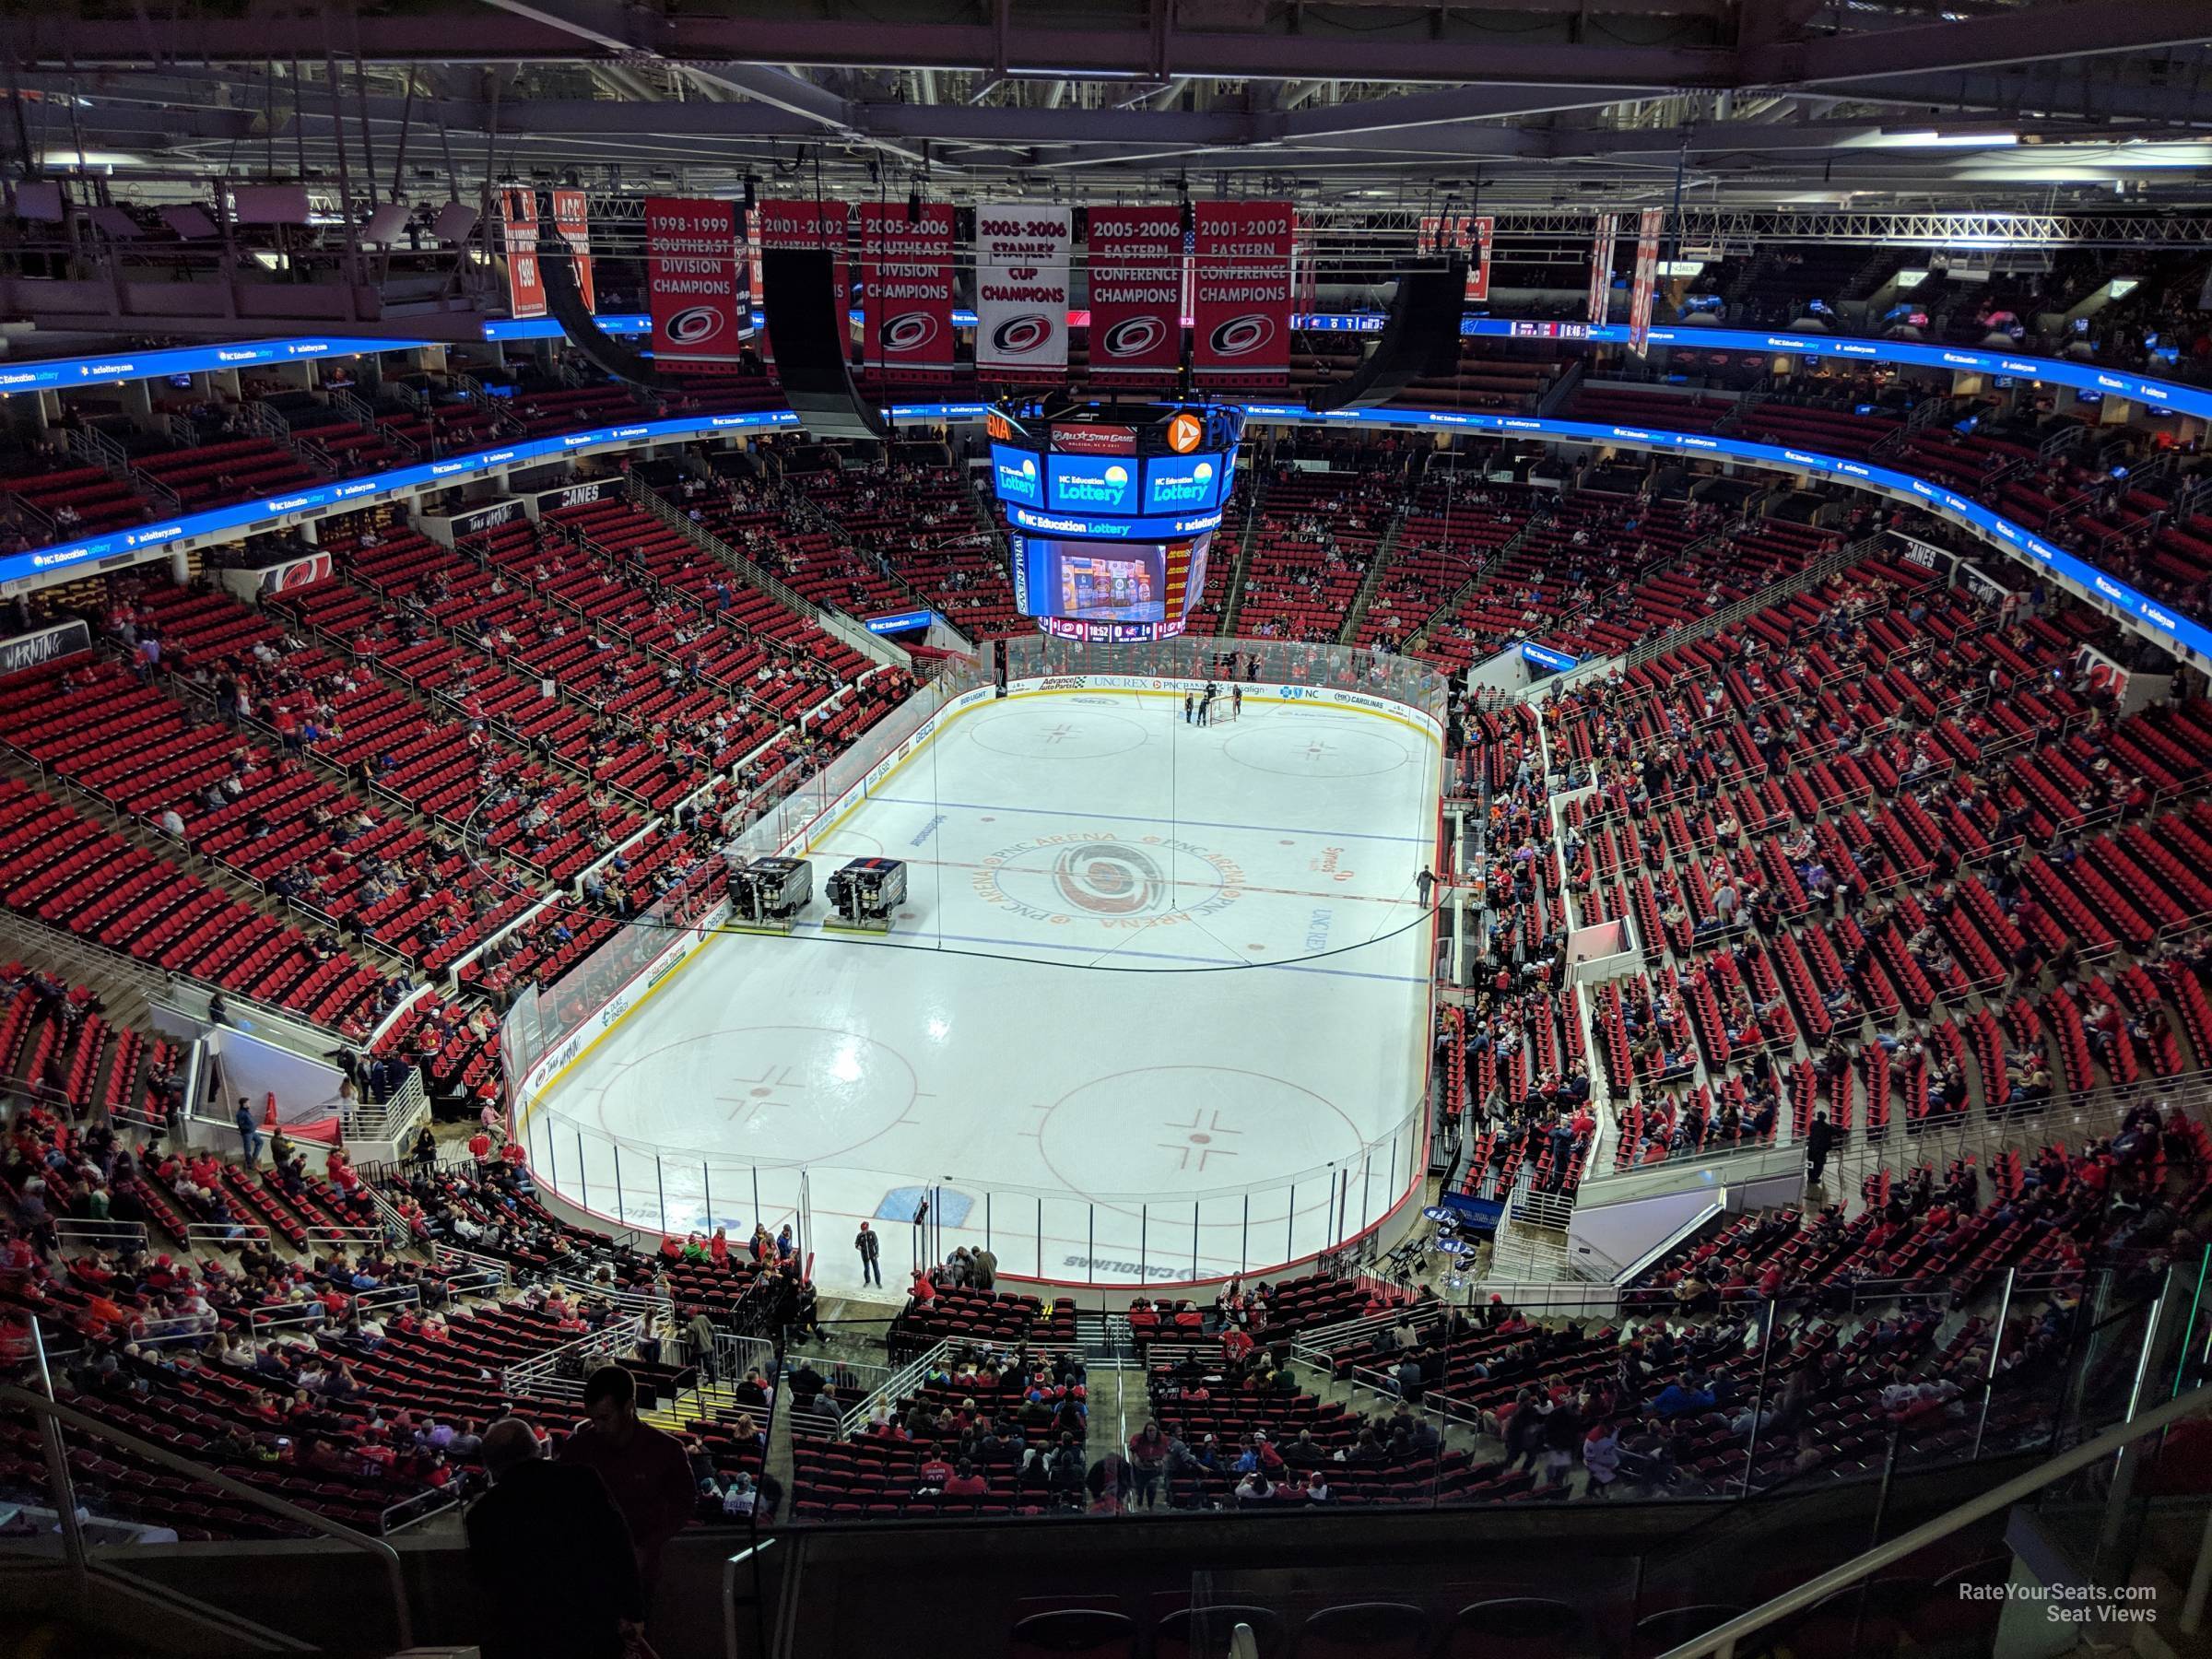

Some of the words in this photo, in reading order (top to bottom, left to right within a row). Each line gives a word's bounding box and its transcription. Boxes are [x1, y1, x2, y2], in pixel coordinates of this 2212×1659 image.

[651, 217, 728, 233] 1998-1999
[764, 219, 842, 235] 2001-2002
[865, 218, 949, 235] 2005-2006
[981, 219, 1067, 238] 2005-2006
[1093, 221, 1180, 238] 2005-2006
[1201, 220, 1288, 237] 2001-2002
[651, 237, 730, 253] SOUTHEAST
[865, 240, 949, 255] SOUTHEAST
[992, 242, 1055, 259] STANLEY
[1104, 243, 1169, 257] EASTERN
[1211, 242, 1276, 257] EASTERN
[661, 258, 722, 274] DIVISION
[876, 265, 939, 277] DIVISION
[1008, 266, 1038, 281] CUP
[1093, 267, 1179, 281] CONFERENCE
[1200, 265, 1288, 281] CONFERENCE
[653, 278, 731, 295] CHAMPIONS
[866, 283, 948, 300] CHAMPIONS
[980, 285, 1065, 303] CHAMPIONS
[1199, 286, 1287, 302] CHAMPIONS
[1093, 287, 1178, 304] CHAMPIONS
[92, 363, 134, 375] nclottery.com
[4, 373, 36, 384] Education
[1086, 433, 1110, 441] STAR
[1110, 434, 1136, 442] GAME
[1000, 472, 1035, 499] Lottery
[1058, 476, 1070, 484] NC
[1071, 476, 1105, 486] Education
[1155, 477, 1165, 486] NC
[1165, 477, 1194, 485] Education
[561, 485, 599, 507] CANES
[1058, 482, 1124, 506] Lottery
[1153, 484, 1208, 502] Lottery
[1025, 514, 1038, 525] NC
[1037, 516, 1087, 532] Education
[1088, 522, 1130, 536] Lottery
[140, 525, 182, 543] nclottery.com
[43, 555, 54, 565] NC
[54, 548, 88, 563] Education
[1904, 541, 1936, 568] CANES
[886, 620, 911, 629] Education
[1076, 623, 1084, 636] 0
[1114, 625, 1123, 637] 0
[5, 633, 63, 670] WARNING
[1094, 677, 1121, 687] UNC
[1124, 678, 1148, 688] REX
[1164, 681, 1182, 689] PNC
[1227, 684, 1265, 695] insalign
[960, 696, 971, 706] BUD
[971, 690, 987, 702] LIGHT
[1305, 688, 1319, 698] NC
[1350, 696, 1384, 709] CAROLINAS
[915, 720, 934, 745] GEICO
[993, 841, 1035, 859] PNC
[1035, 832, 1119, 846] ARENA
[1163, 838, 1209, 854] PNC
[1321, 846, 1346, 874] Syneos
[1002, 902, 1051, 922] PNC
[1192, 897, 1236, 916] PNC
[1310, 908, 1333, 931] UNC
[1305, 931, 1328, 953] REX
[610, 995, 623, 1013] DUKE
[611, 1002, 629, 1022] ENERGY
[1063, 1255, 1175, 1279] CAROLINAS
